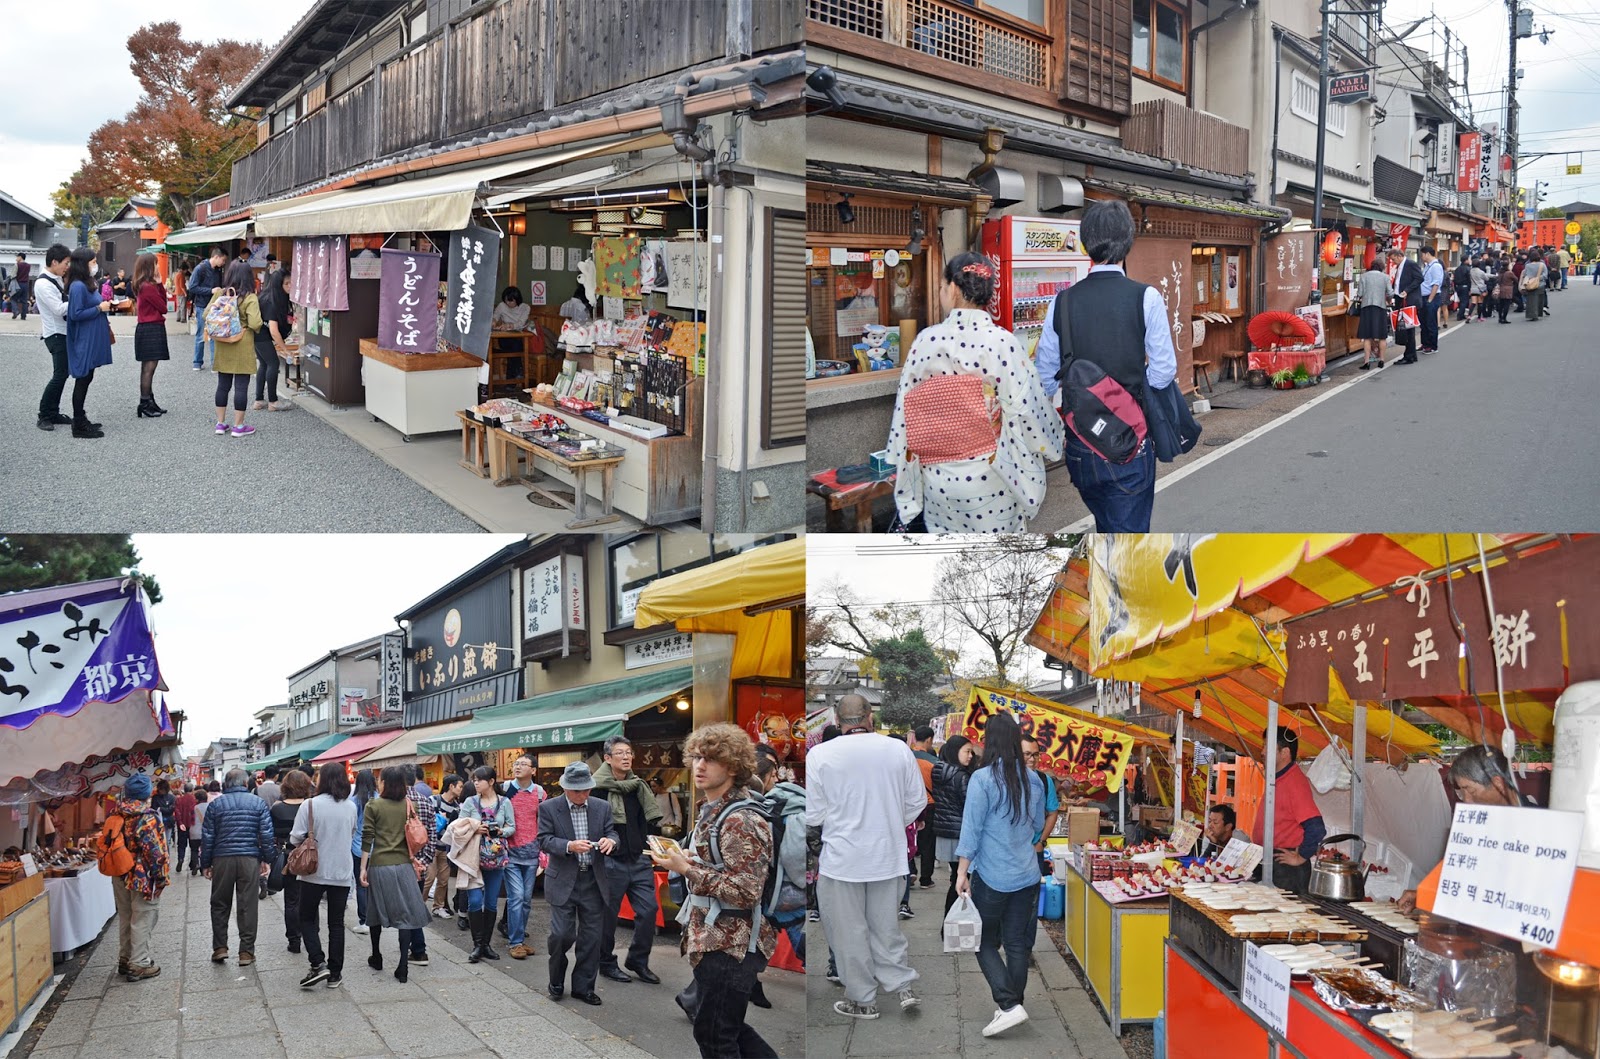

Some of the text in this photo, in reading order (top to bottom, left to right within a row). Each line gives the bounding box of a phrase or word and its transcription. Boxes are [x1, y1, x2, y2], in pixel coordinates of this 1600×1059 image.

[1331, 83, 1368, 95] HANEIKAI
[1335, 77, 1364, 88] INARI
[396, 256, 423, 346] うどん・そば
[988, 692, 1027, 714] 特製
[966, 694, 1123, 776] たやき大魔王
[1455, 809, 1489, 825] 五平餅
[1450, 831, 1568, 860] Miso rice cake pops
[1440, 878, 1461, 897] 된장
[1467, 883, 1478, 901] 떡
[1519, 921, 1555, 944] ¥400
